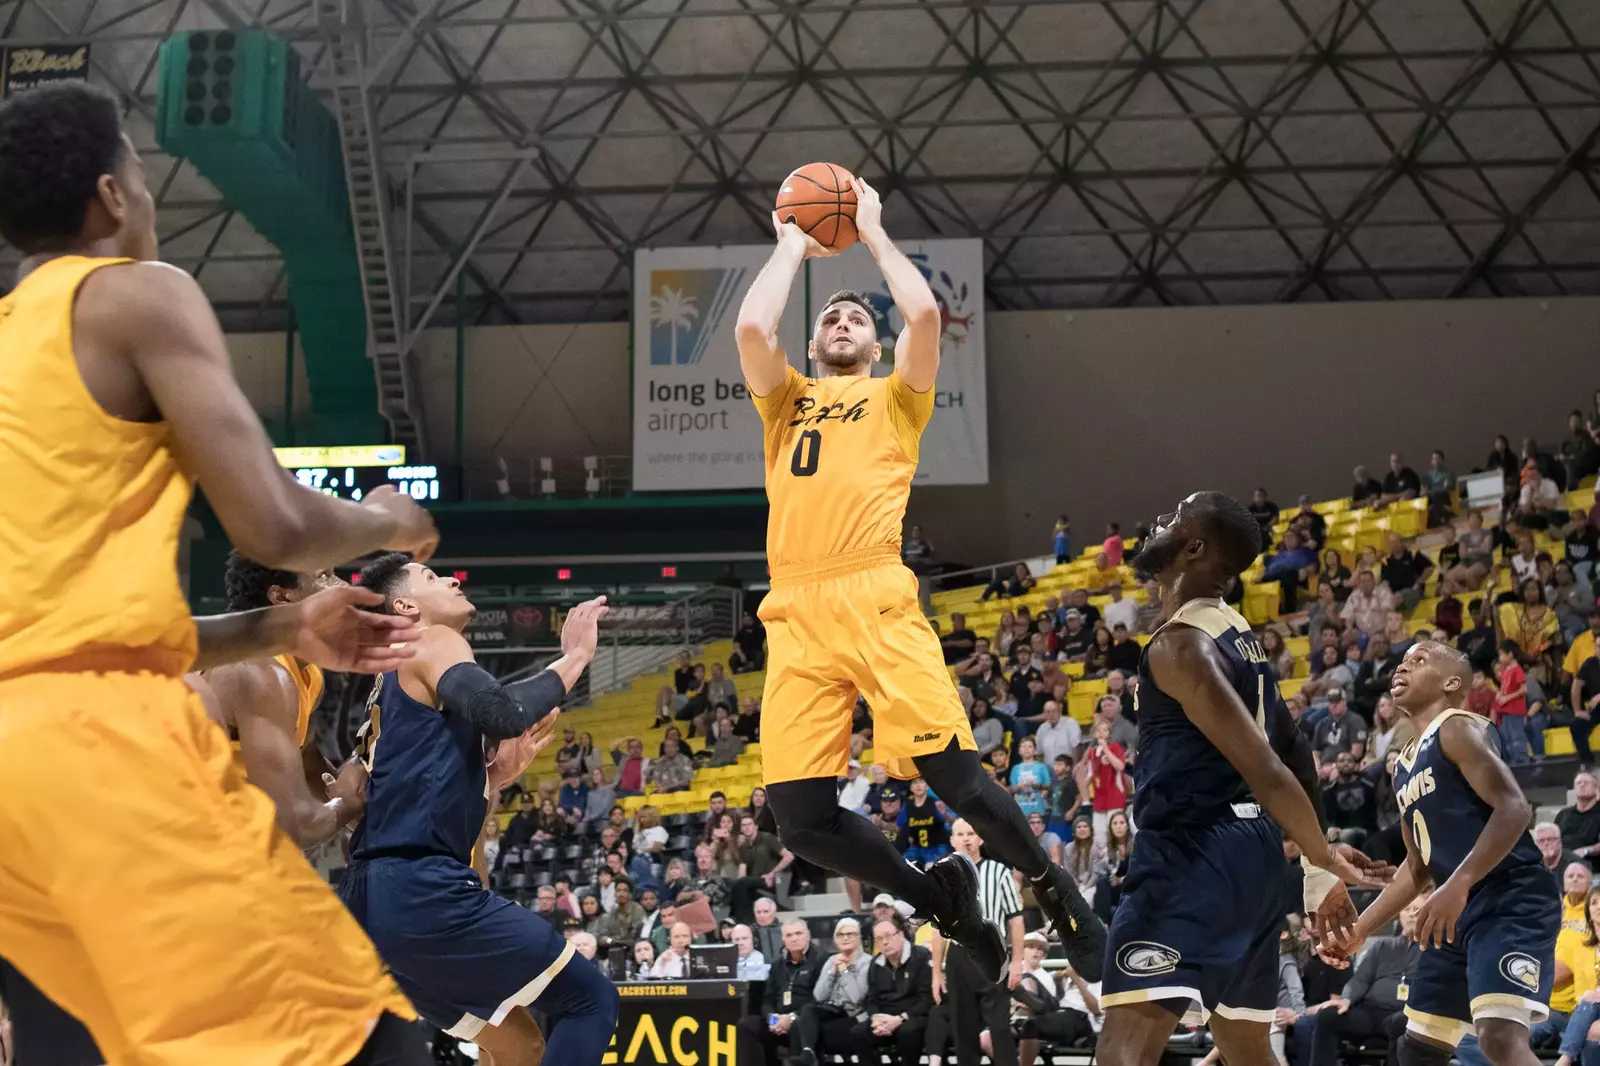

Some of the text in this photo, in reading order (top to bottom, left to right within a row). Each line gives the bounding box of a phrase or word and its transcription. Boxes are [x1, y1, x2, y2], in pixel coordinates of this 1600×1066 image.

[649, 377, 752, 406] long be
[648, 408, 729, 435] airport
[790, 429, 822, 476] 0
[1396, 766, 1436, 816] DAVIS
[616, 985, 688, 997] EACHSTATE.COM
[601, 1013, 737, 1066] ACH
